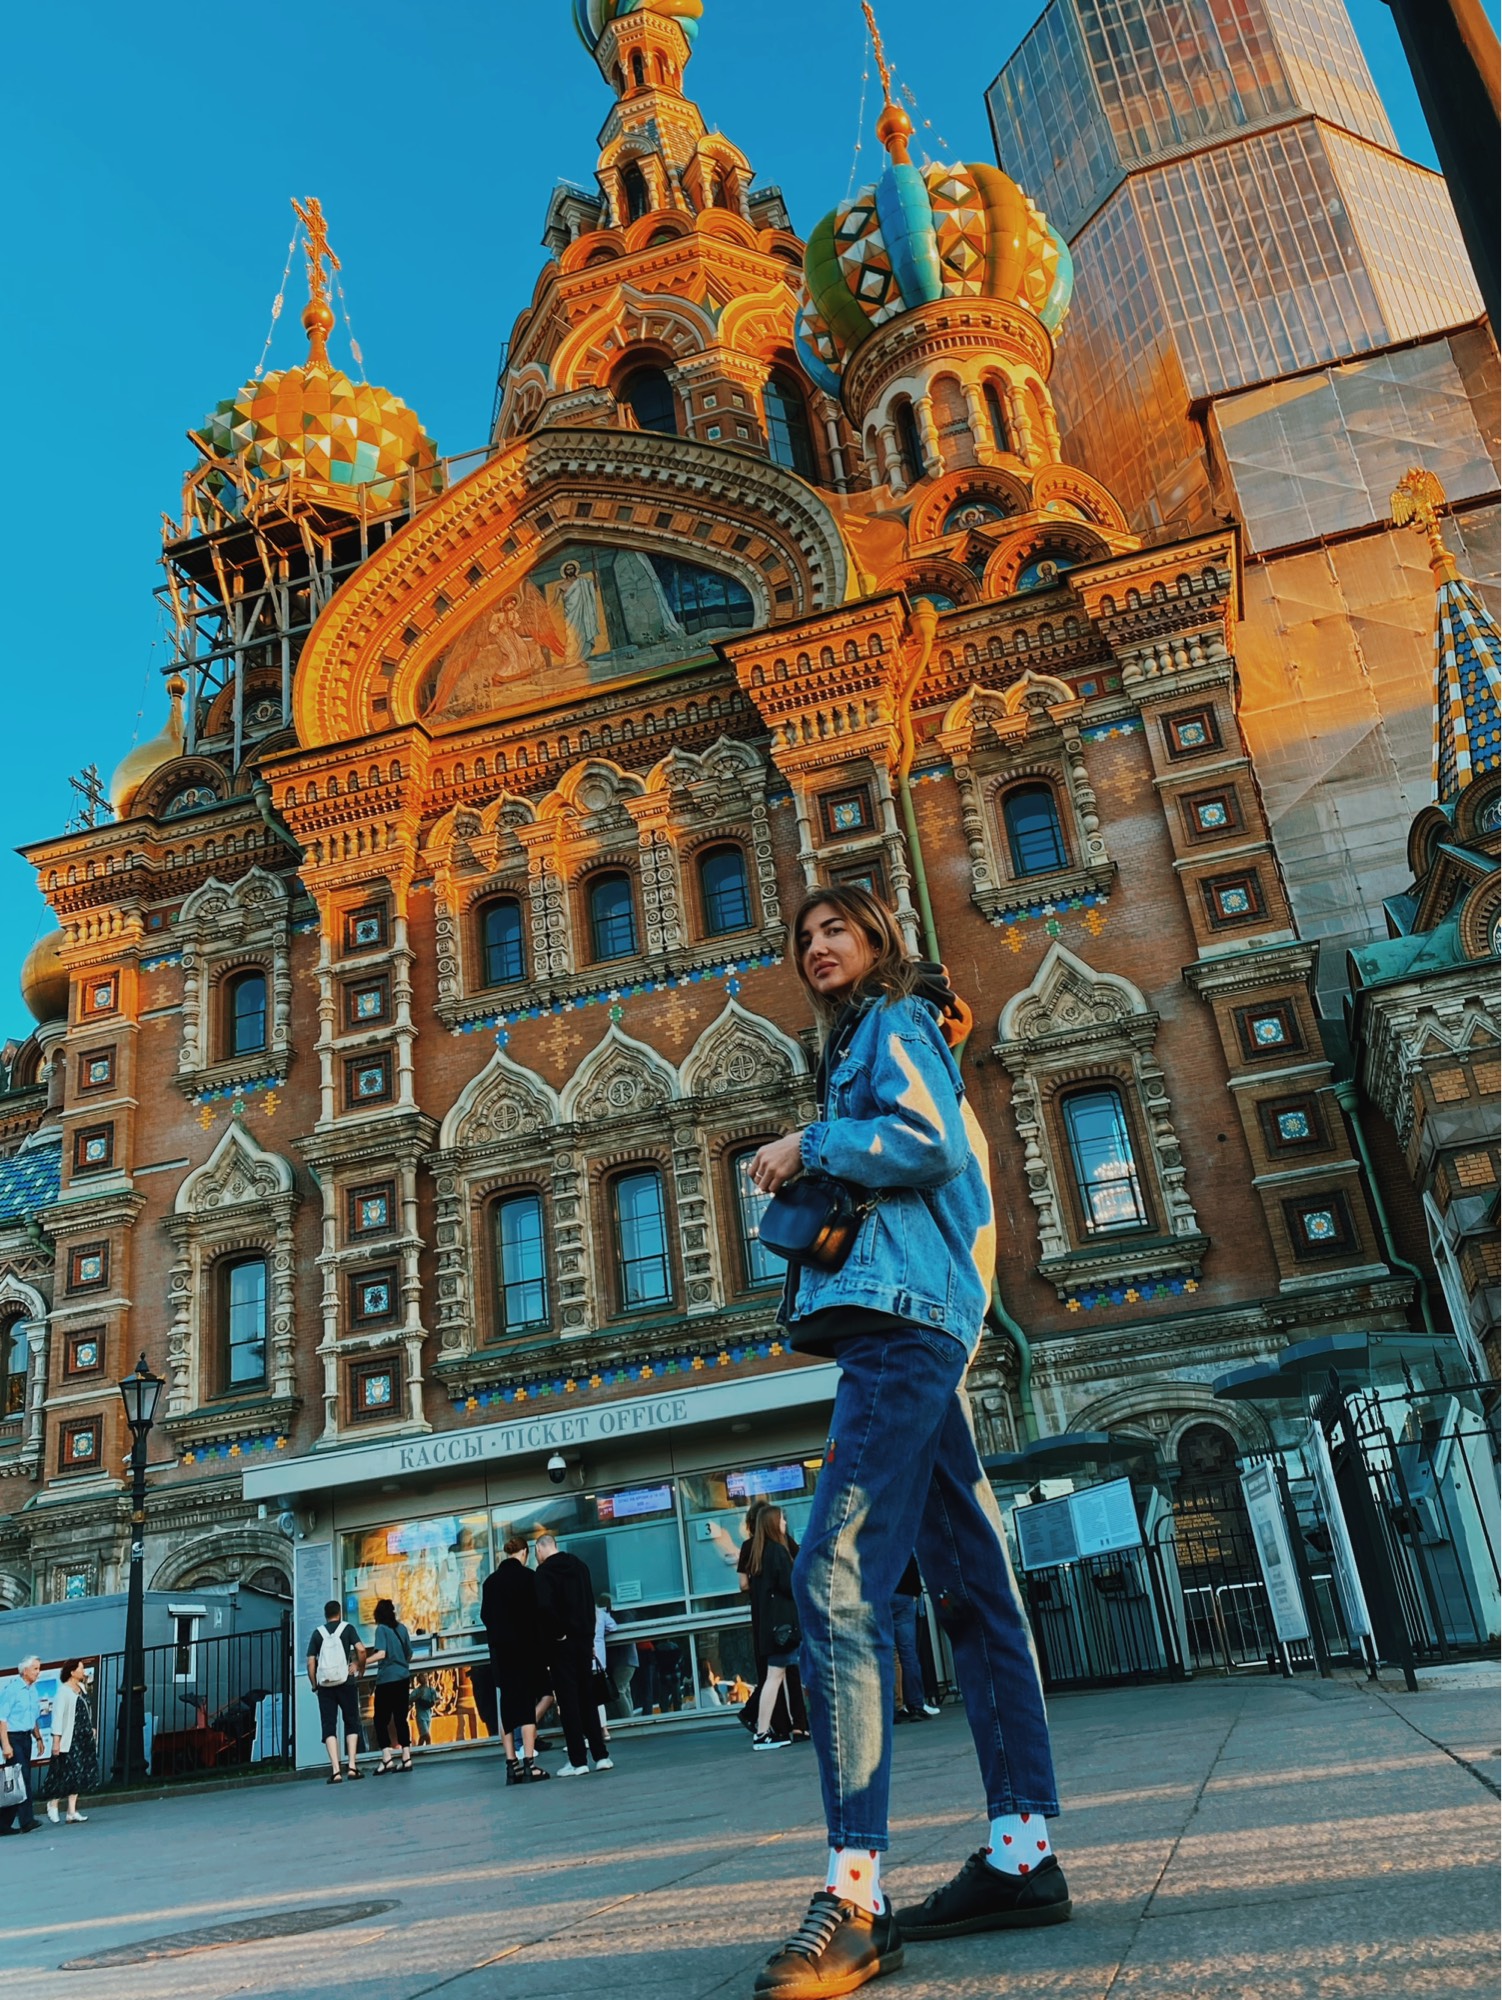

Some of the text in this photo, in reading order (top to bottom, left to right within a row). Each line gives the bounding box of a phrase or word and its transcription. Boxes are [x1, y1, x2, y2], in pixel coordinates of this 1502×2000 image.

[400, 1399, 688, 1470] КАССЫ TICKET OFFICE
[704, 1522, 712, 1536] 3
